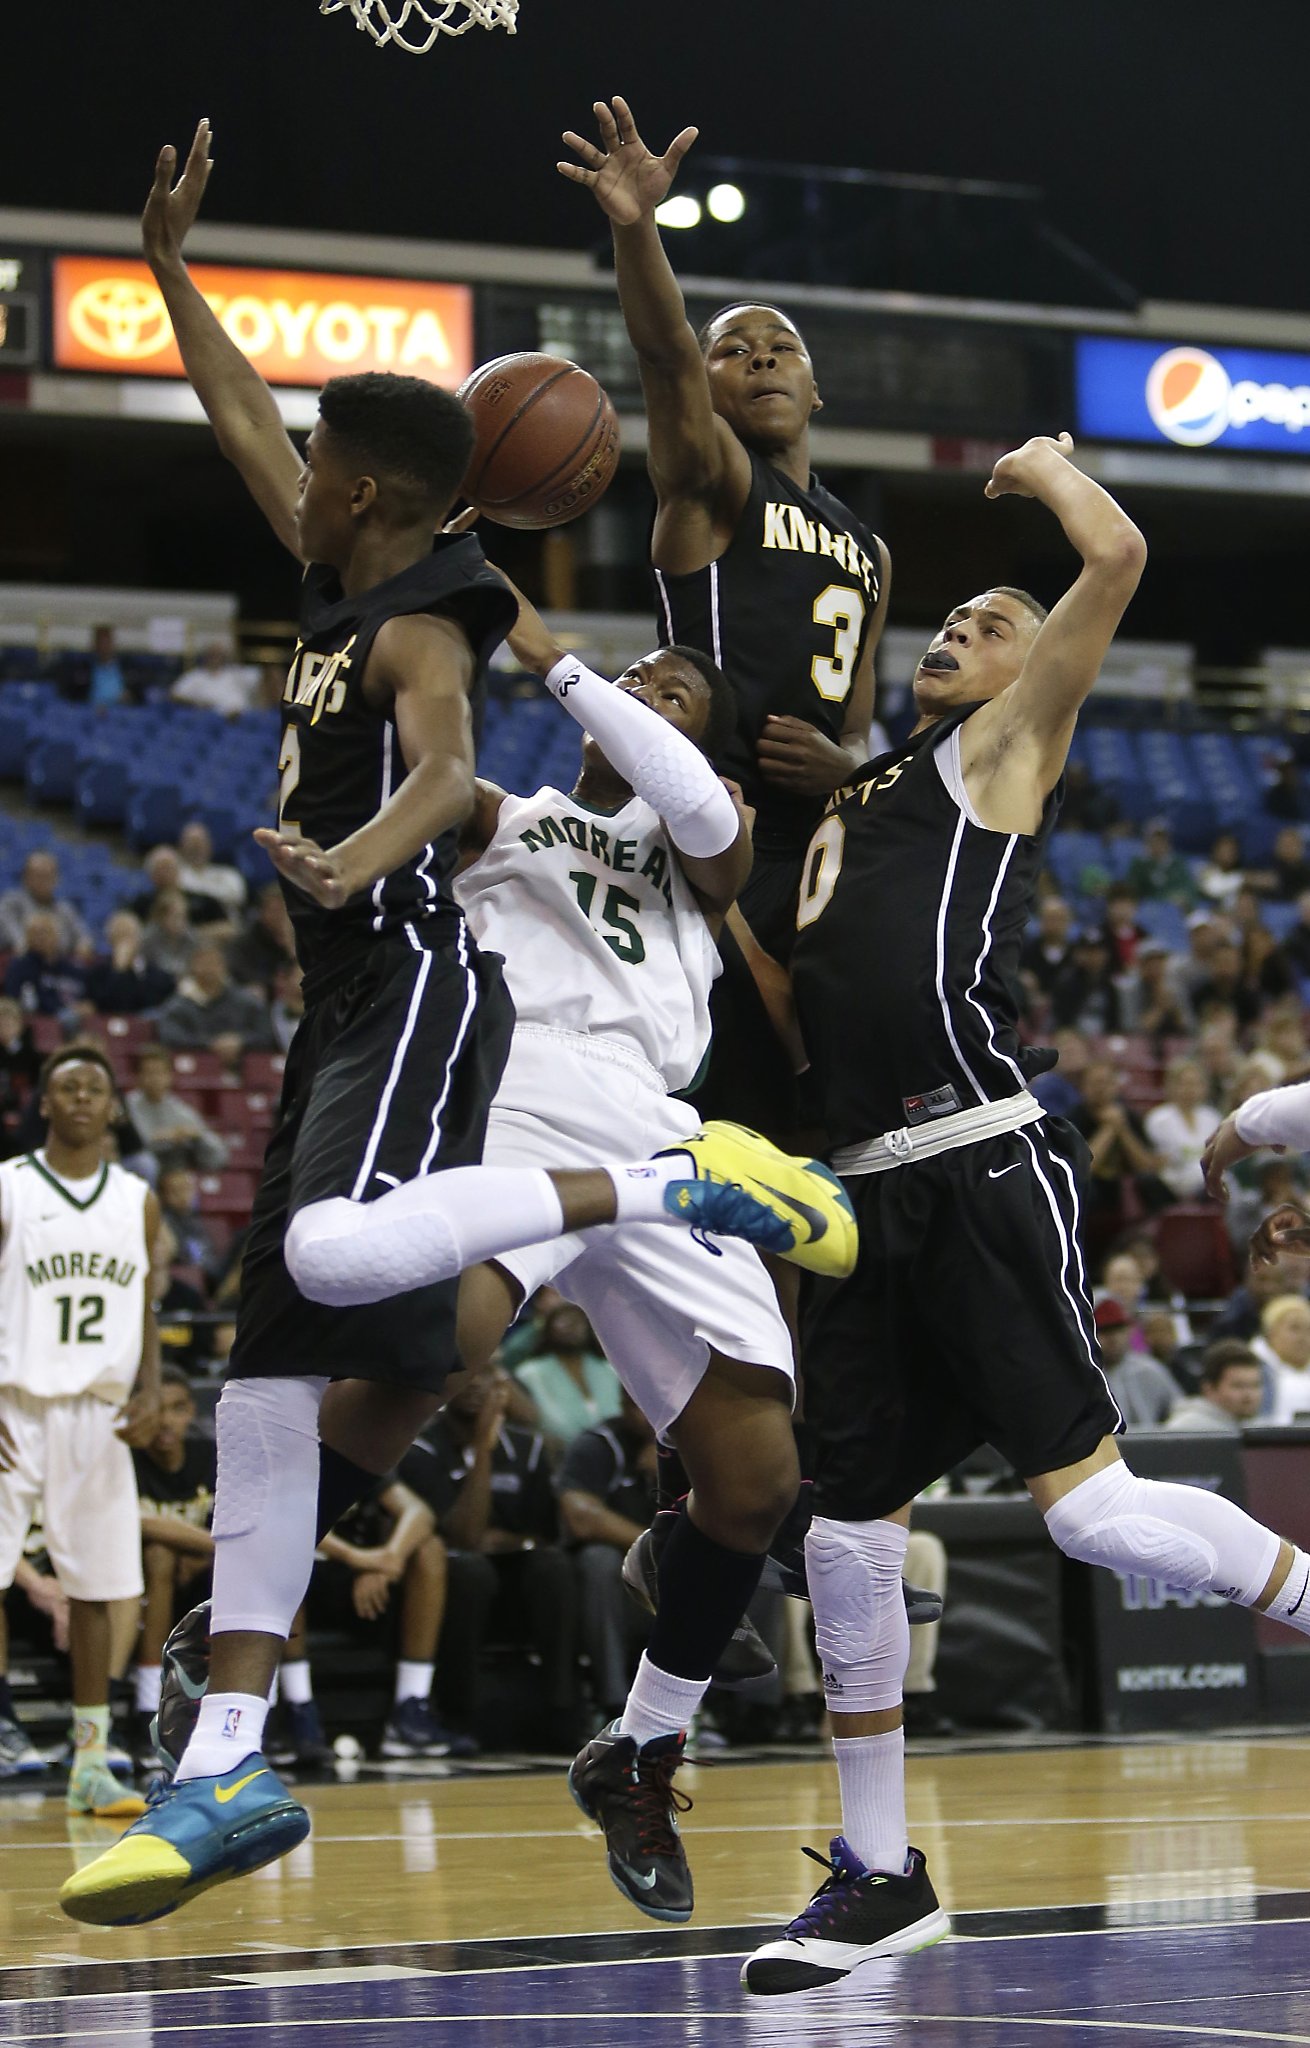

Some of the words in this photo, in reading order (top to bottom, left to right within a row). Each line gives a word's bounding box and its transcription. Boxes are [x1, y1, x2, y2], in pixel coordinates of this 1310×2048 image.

[811, 584, 866, 702] 3
[519, 815, 673, 908] MOREA
[796, 814, 846, 931] 0
[569, 871, 645, 965] 15
[26, 1251, 137, 1288] MOREAU
[55, 1294, 105, 1344] 12
